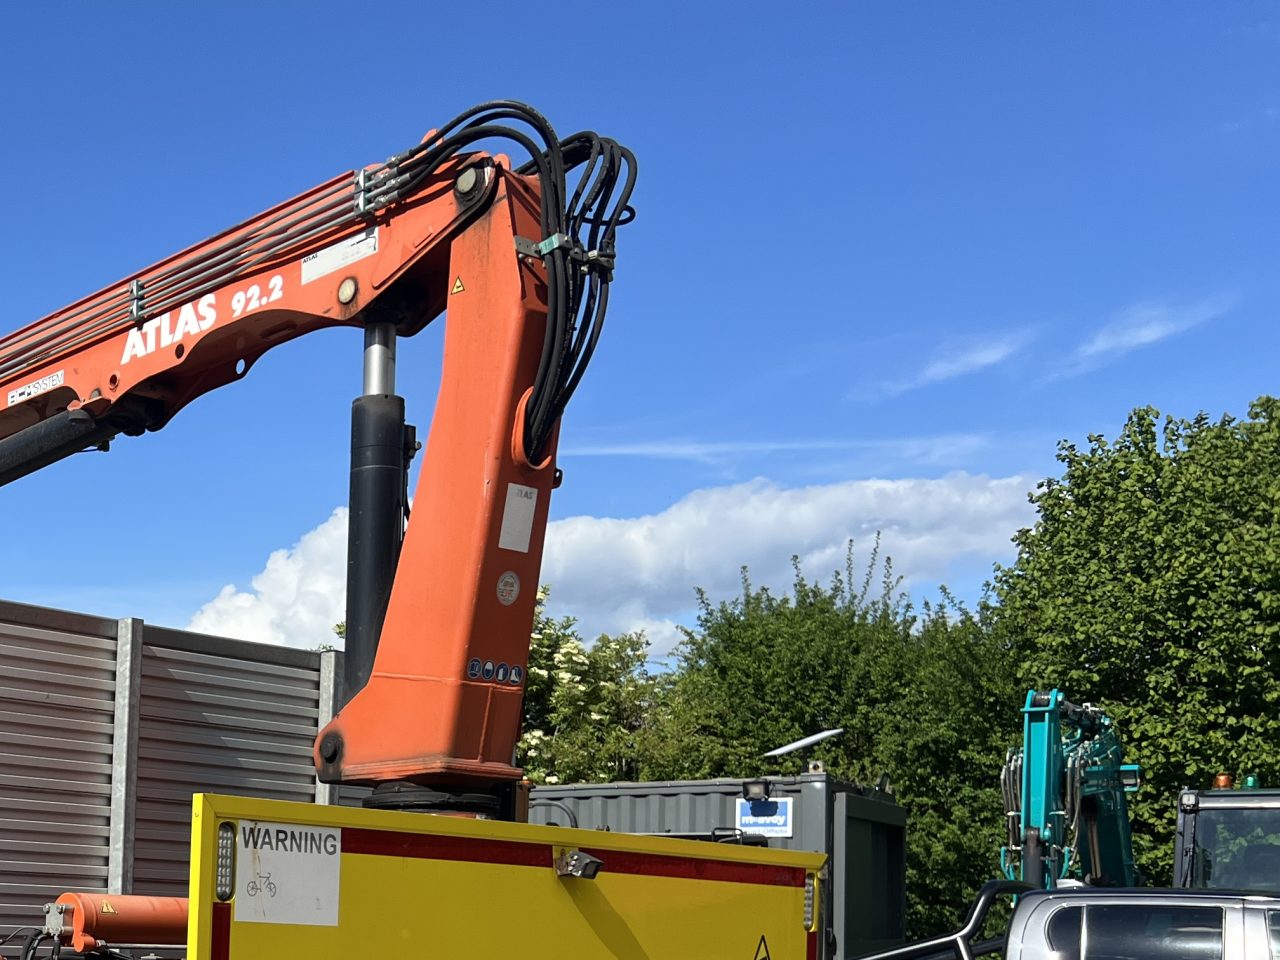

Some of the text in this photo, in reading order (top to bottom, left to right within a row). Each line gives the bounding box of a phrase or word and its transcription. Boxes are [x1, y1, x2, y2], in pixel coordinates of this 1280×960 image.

[121, 275, 283, 365] ATLAS 92.2
[242, 826, 337, 856] WARNING
